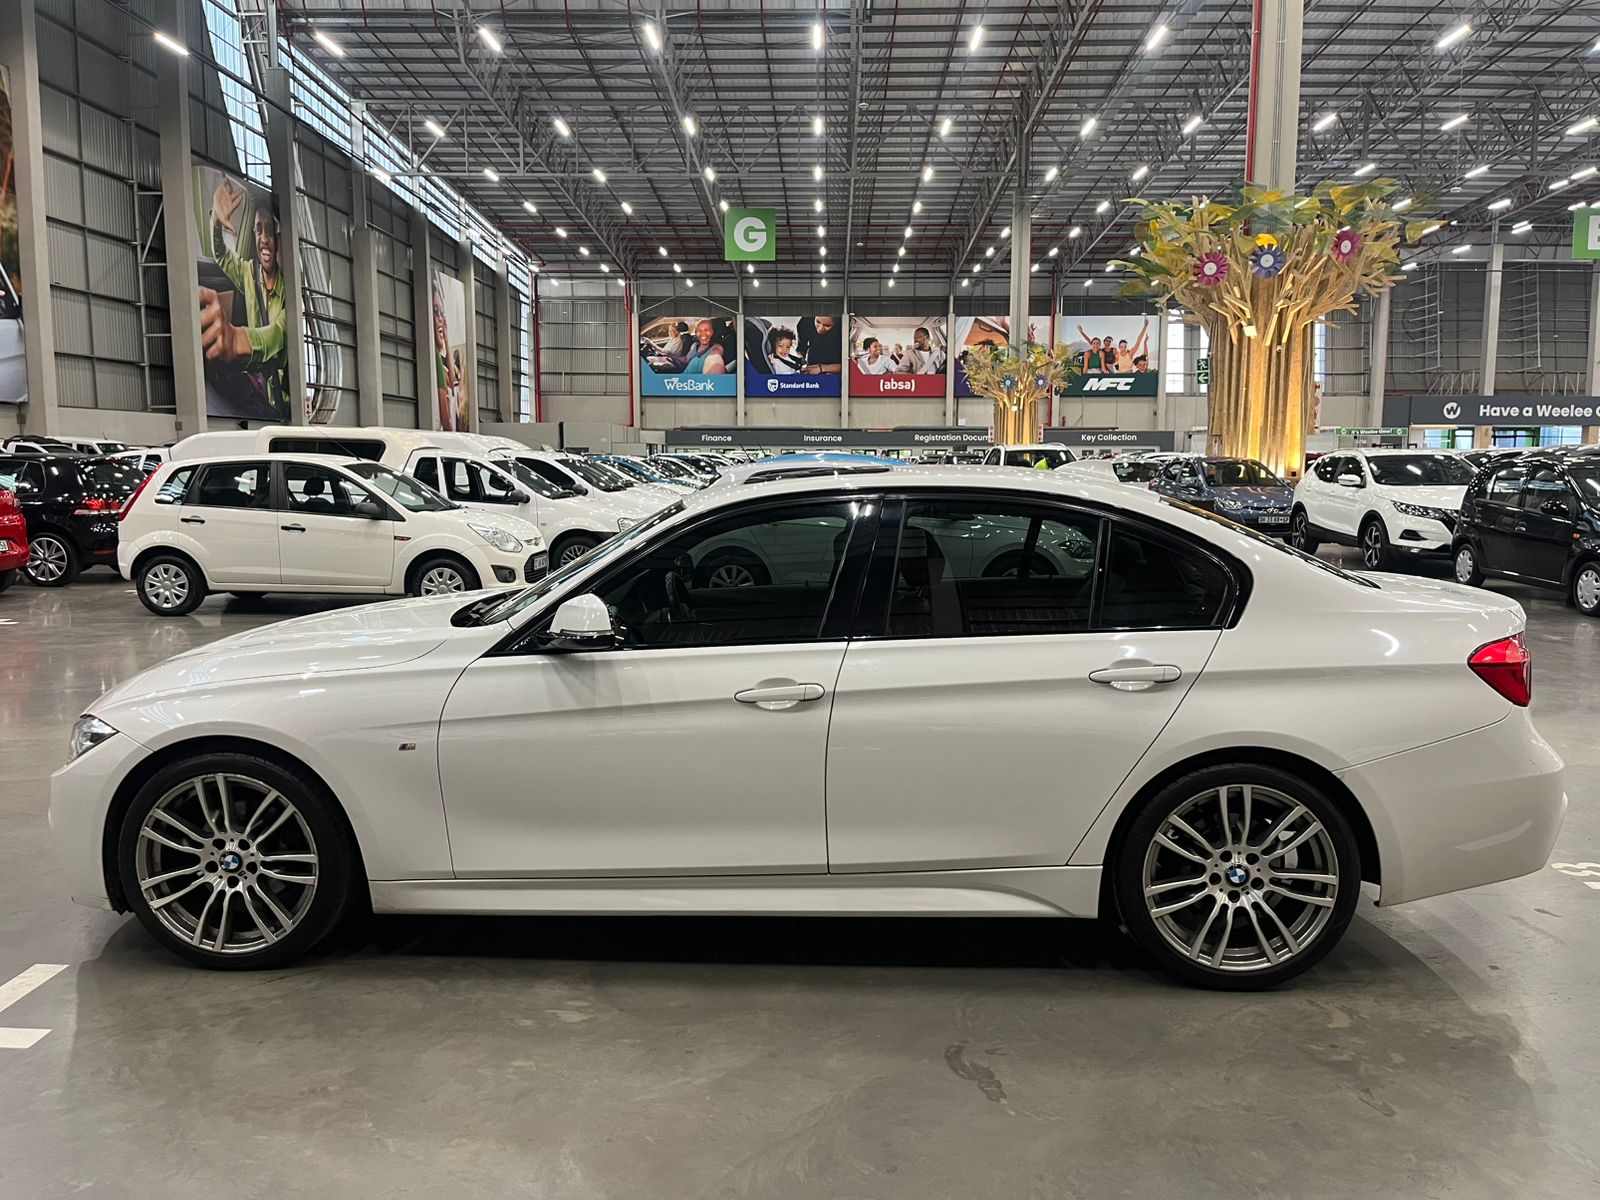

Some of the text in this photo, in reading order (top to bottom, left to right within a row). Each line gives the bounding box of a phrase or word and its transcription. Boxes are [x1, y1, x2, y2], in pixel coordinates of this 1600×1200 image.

[734, 216, 767, 252] G
[664, 377, 715, 391] WesBank
[1083, 378, 1135, 391] MFC
[1479, 404, 1520, 417] Have
[1522, 407, 1533, 417] a
[1536, 404, 1593, 417] Weelee
[701, 434, 732, 442] Finance
[803, 434, 843, 442] Insurance
[914, 434, 962, 443] Registration
[1081, 433, 1137, 443] Key Collection
